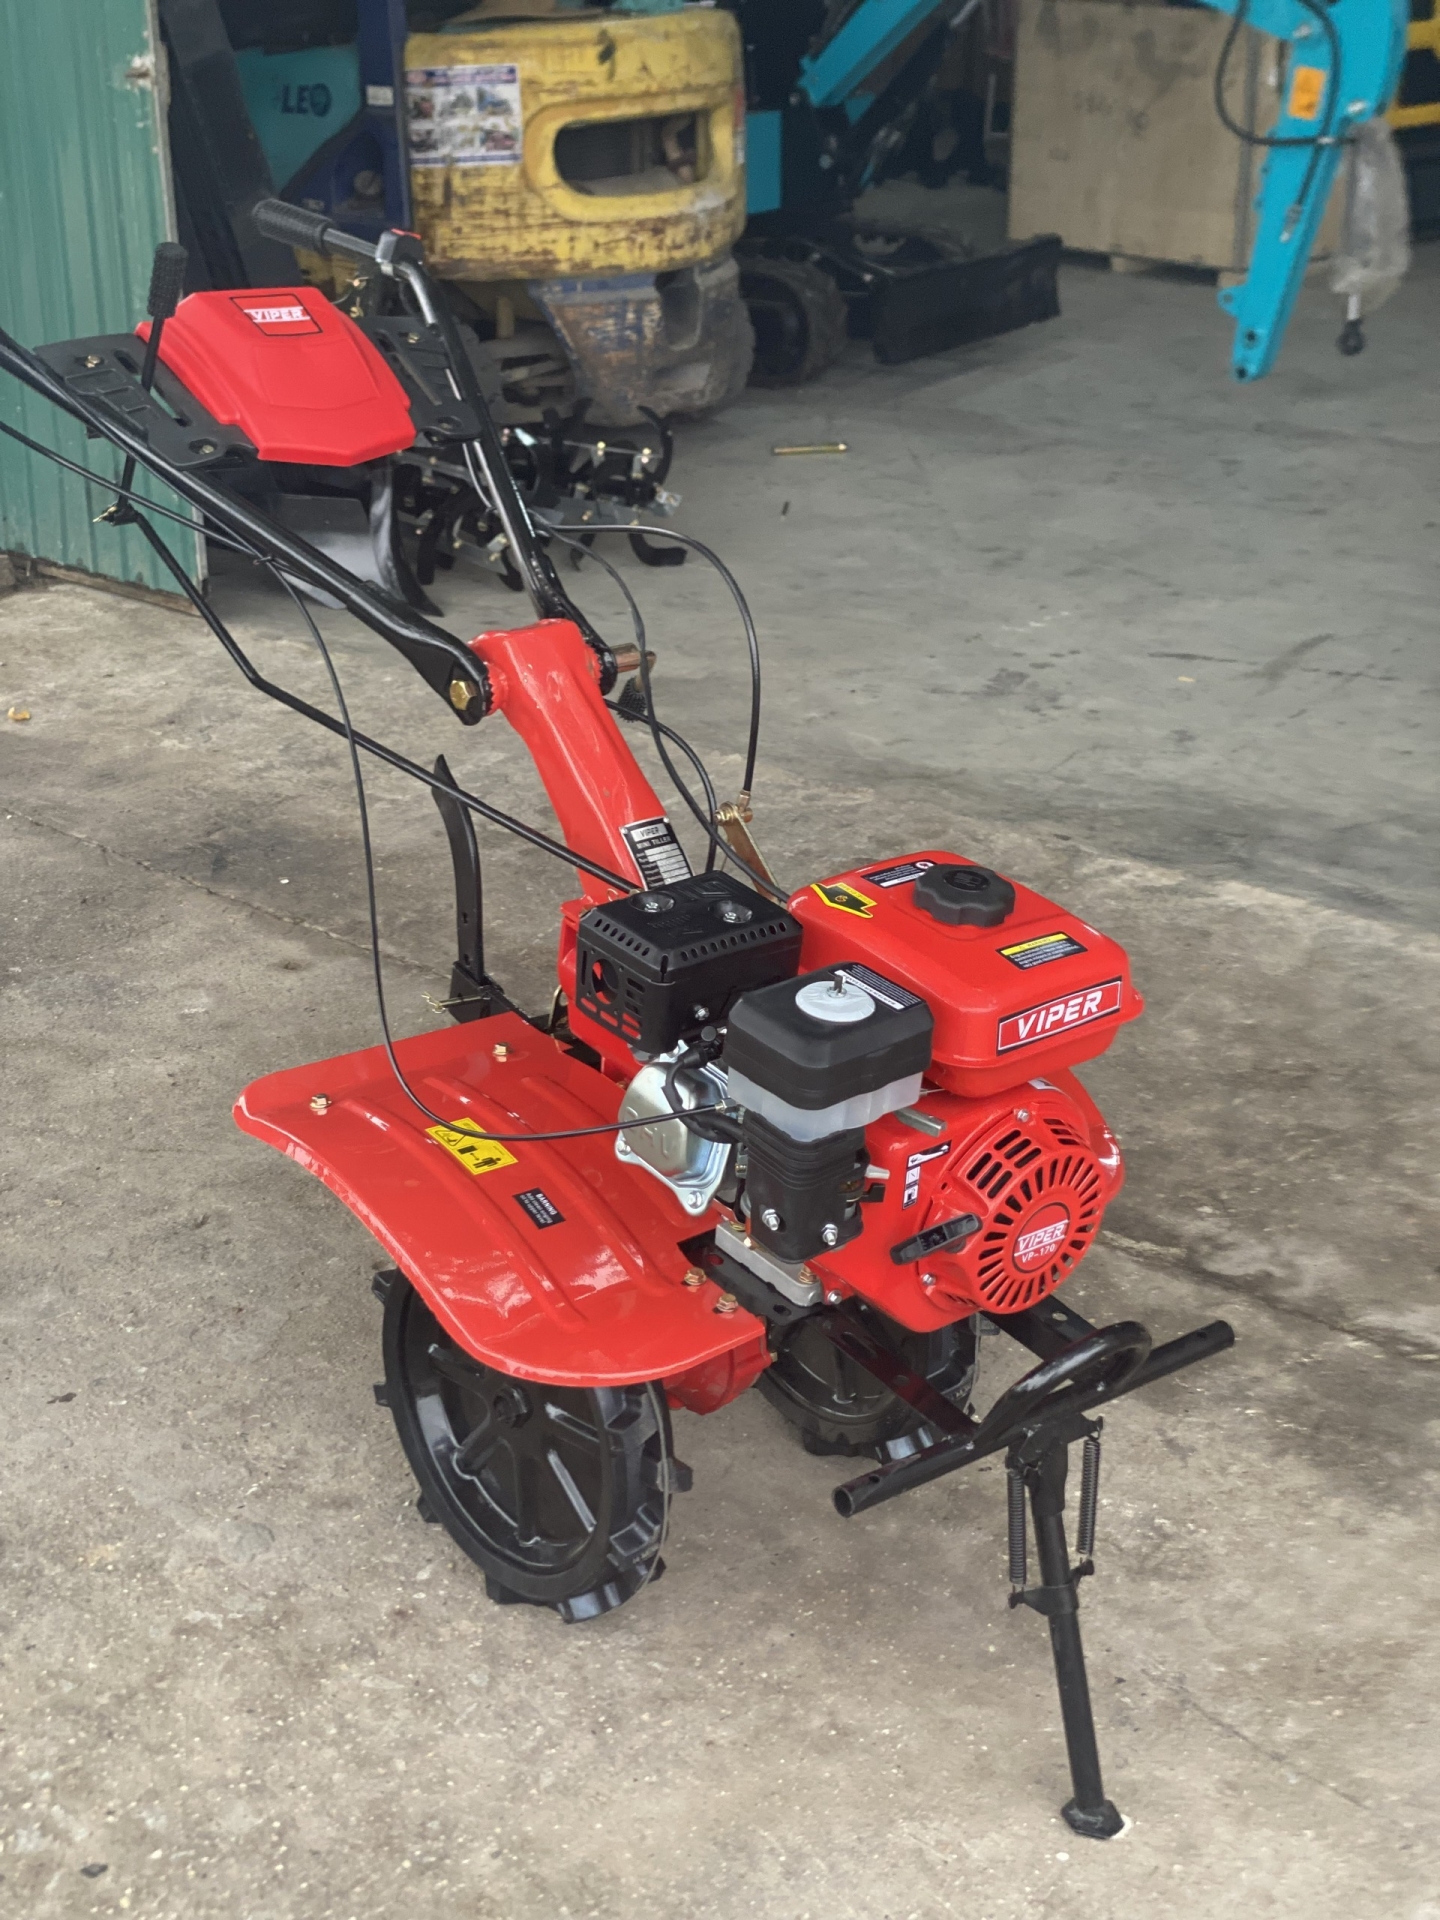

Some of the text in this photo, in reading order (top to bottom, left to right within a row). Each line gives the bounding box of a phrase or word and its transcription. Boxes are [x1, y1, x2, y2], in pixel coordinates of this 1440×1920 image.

[248, 308, 304, 321] VIPER
[640, 826, 660, 838] VIPER
[652, 835, 672, 846] TILLER
[1017, 990, 1103, 1040] VIPER
[1018, 1224, 1065, 1252] VIPER
[1021, 1243, 1057, 1263] VP-170
